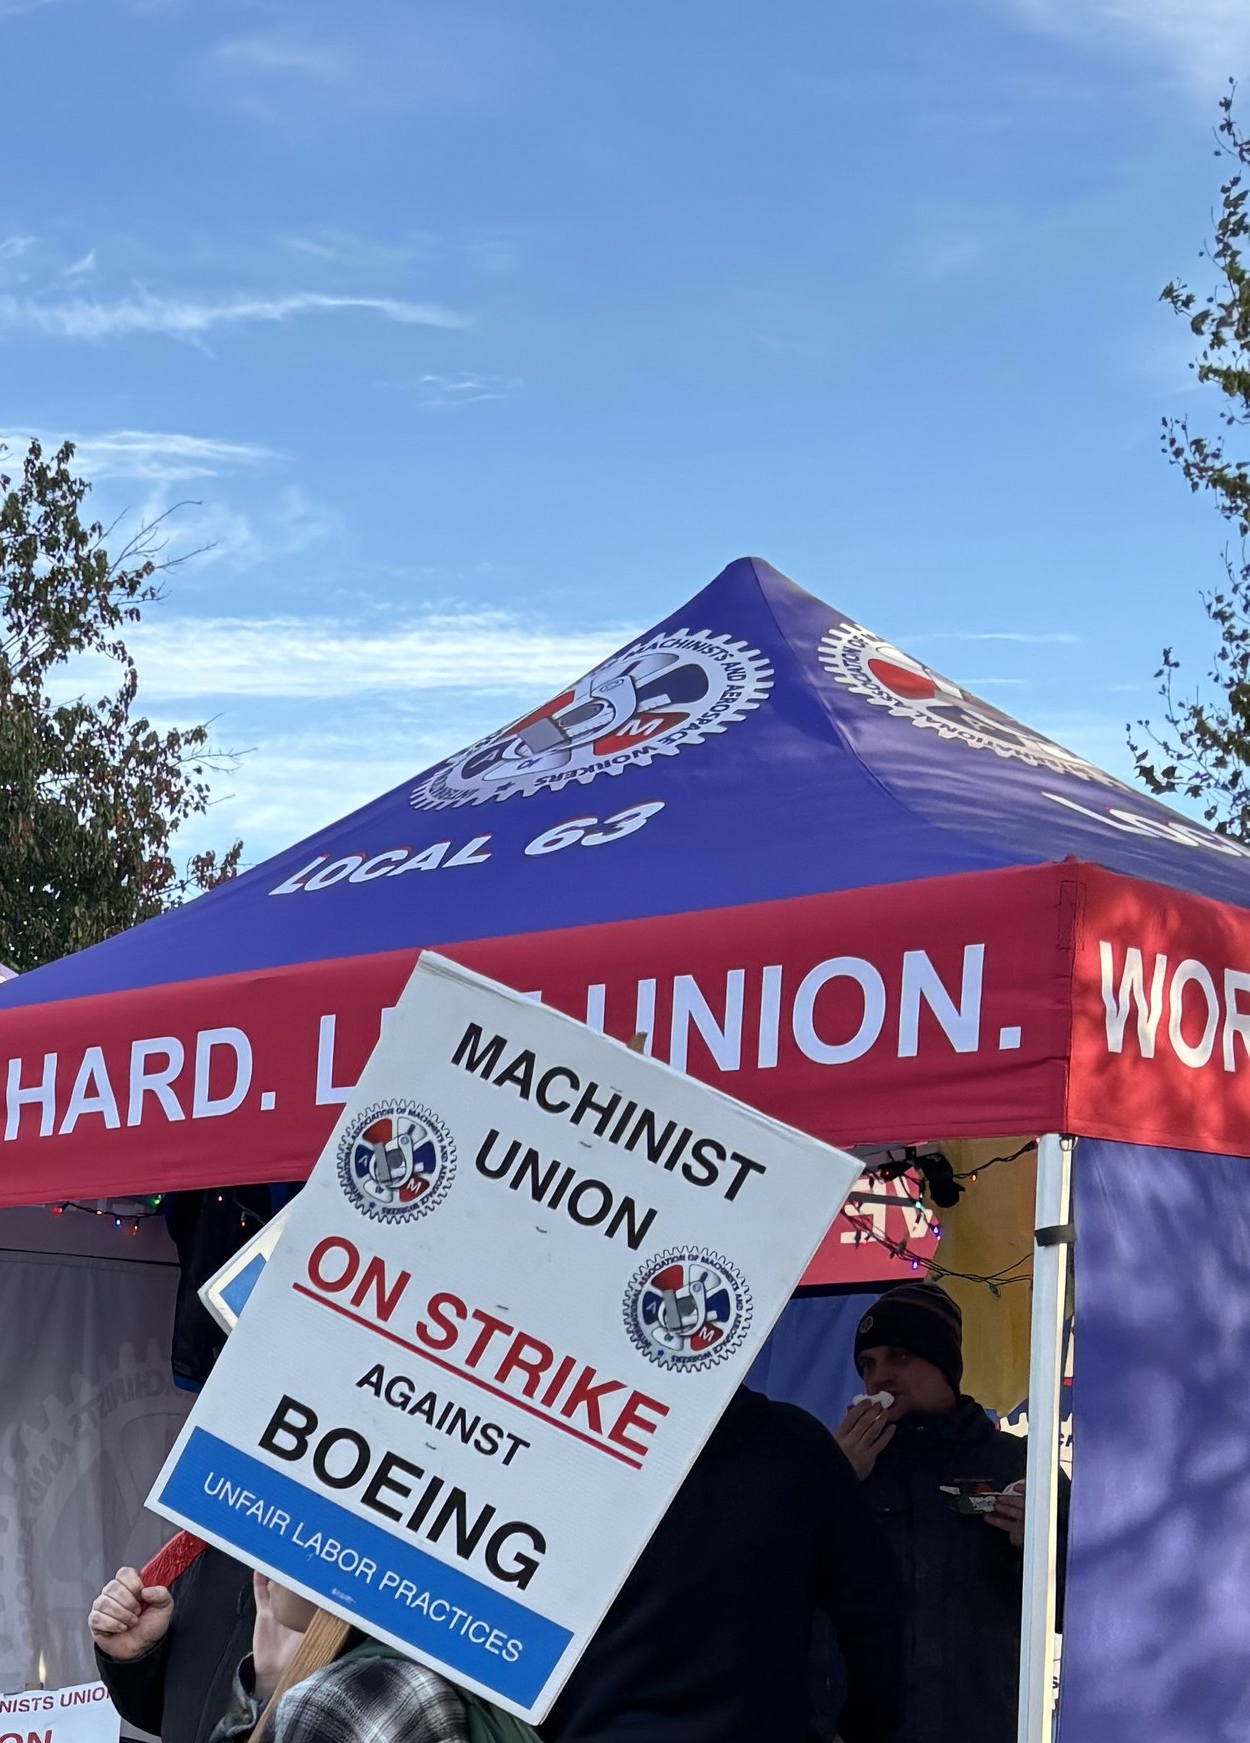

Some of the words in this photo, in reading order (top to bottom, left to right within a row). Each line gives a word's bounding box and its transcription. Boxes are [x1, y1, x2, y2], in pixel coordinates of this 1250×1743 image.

[657, 684, 746, 745] AEROSPACE
[721, 661, 747, 682] AND
[534, 745, 661, 787] WORKERS
[269, 833, 491, 896] LOCAL
[524, 801, 665, 855] 63
[4, 1027, 276, 1142] HARD.
[450, 1022, 766, 1203] MACHINIST
[406, 1178, 421, 1194] M
[475, 1128, 657, 1251] UNION
[307, 1235, 410, 1324] ON
[416, 1291, 669, 1456] STRIKE
[699, 1326, 714, 1342] M
[357, 1363, 530, 1466] AGAINST
[258, 1394, 546, 1591] BOEING
[204, 1471, 289, 1535] UNFAIR
[291, 1519, 377, 1584] LABOR
[378, 1570, 523, 1663] PRACTICES
